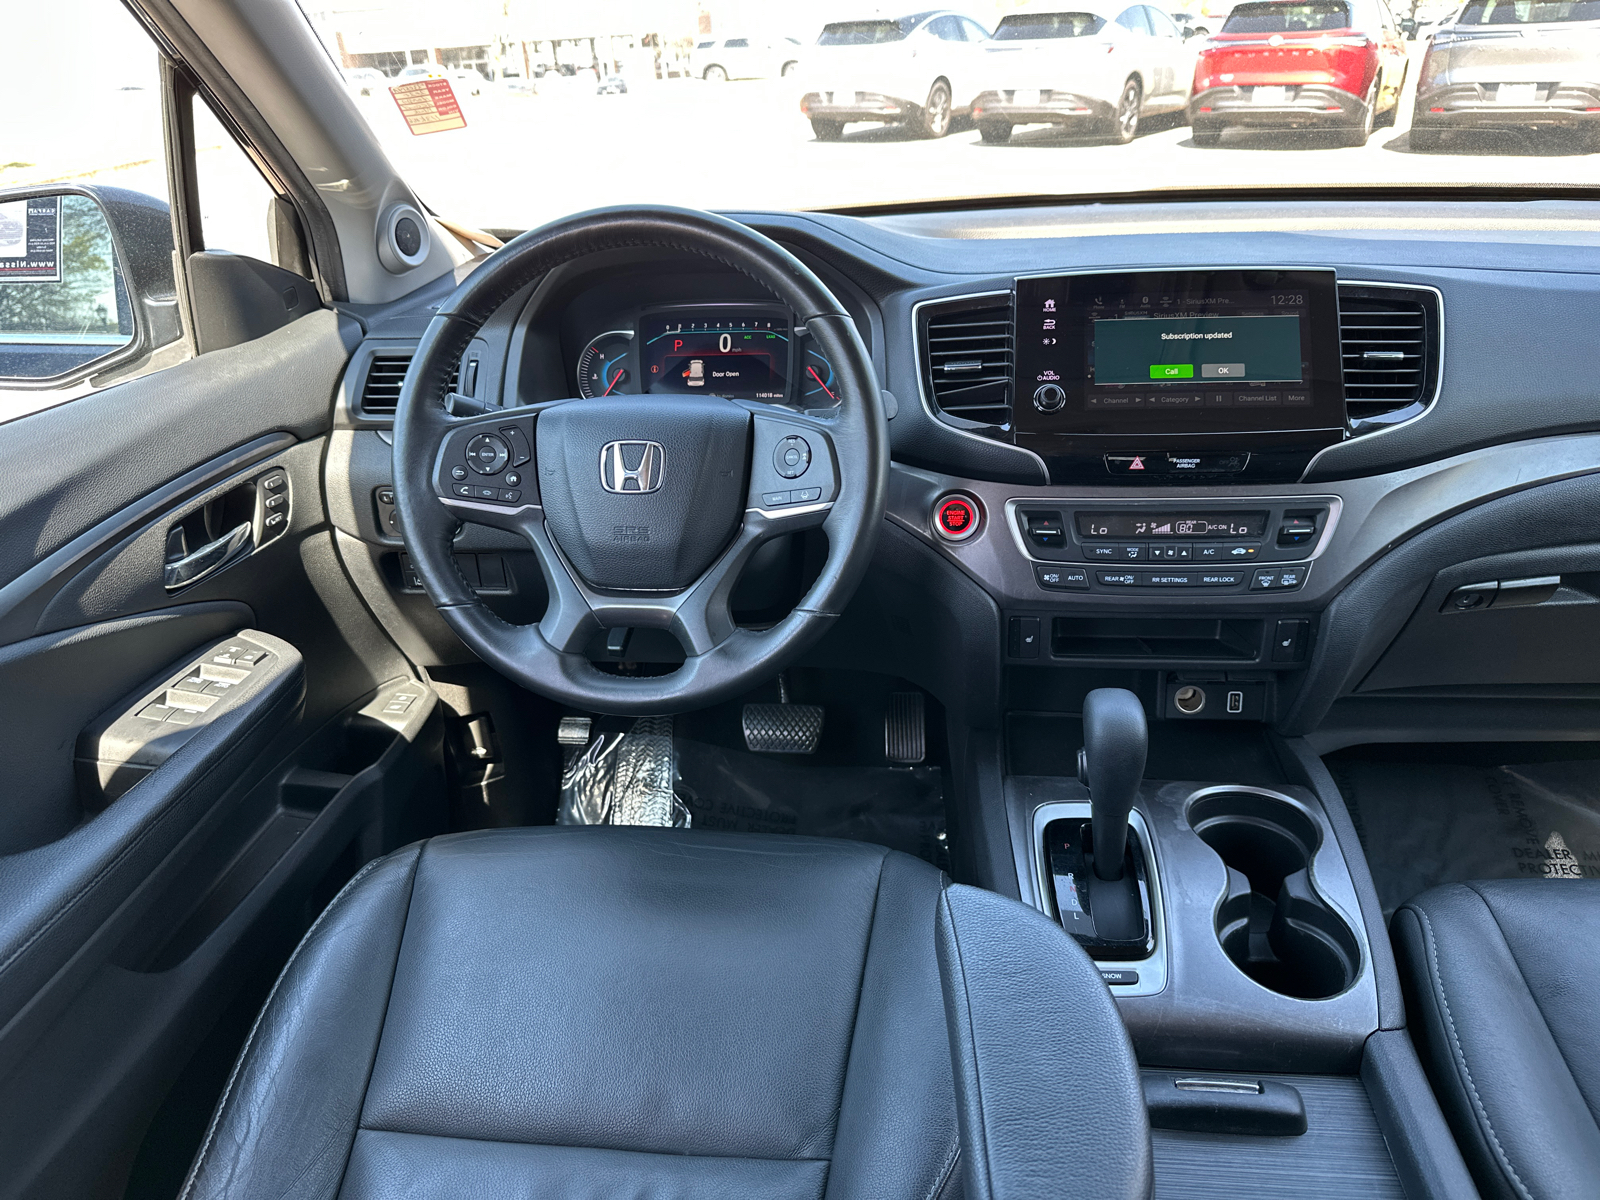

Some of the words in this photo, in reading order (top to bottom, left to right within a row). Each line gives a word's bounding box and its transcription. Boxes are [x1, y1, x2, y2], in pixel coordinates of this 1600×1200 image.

[1270, 295, 1303, 305] 12:28
[1161, 332, 1204, 340] Subscription
[1204, 332, 1232, 340] updated
[674, 340, 683, 352] P
[719, 333, 732, 353] 0
[1090, 524, 1108, 535] Lo
[1179, 524, 1193, 533] 80
[1230, 523, 1247, 534] Lo
[1512, 848, 1573, 860] DEALER
